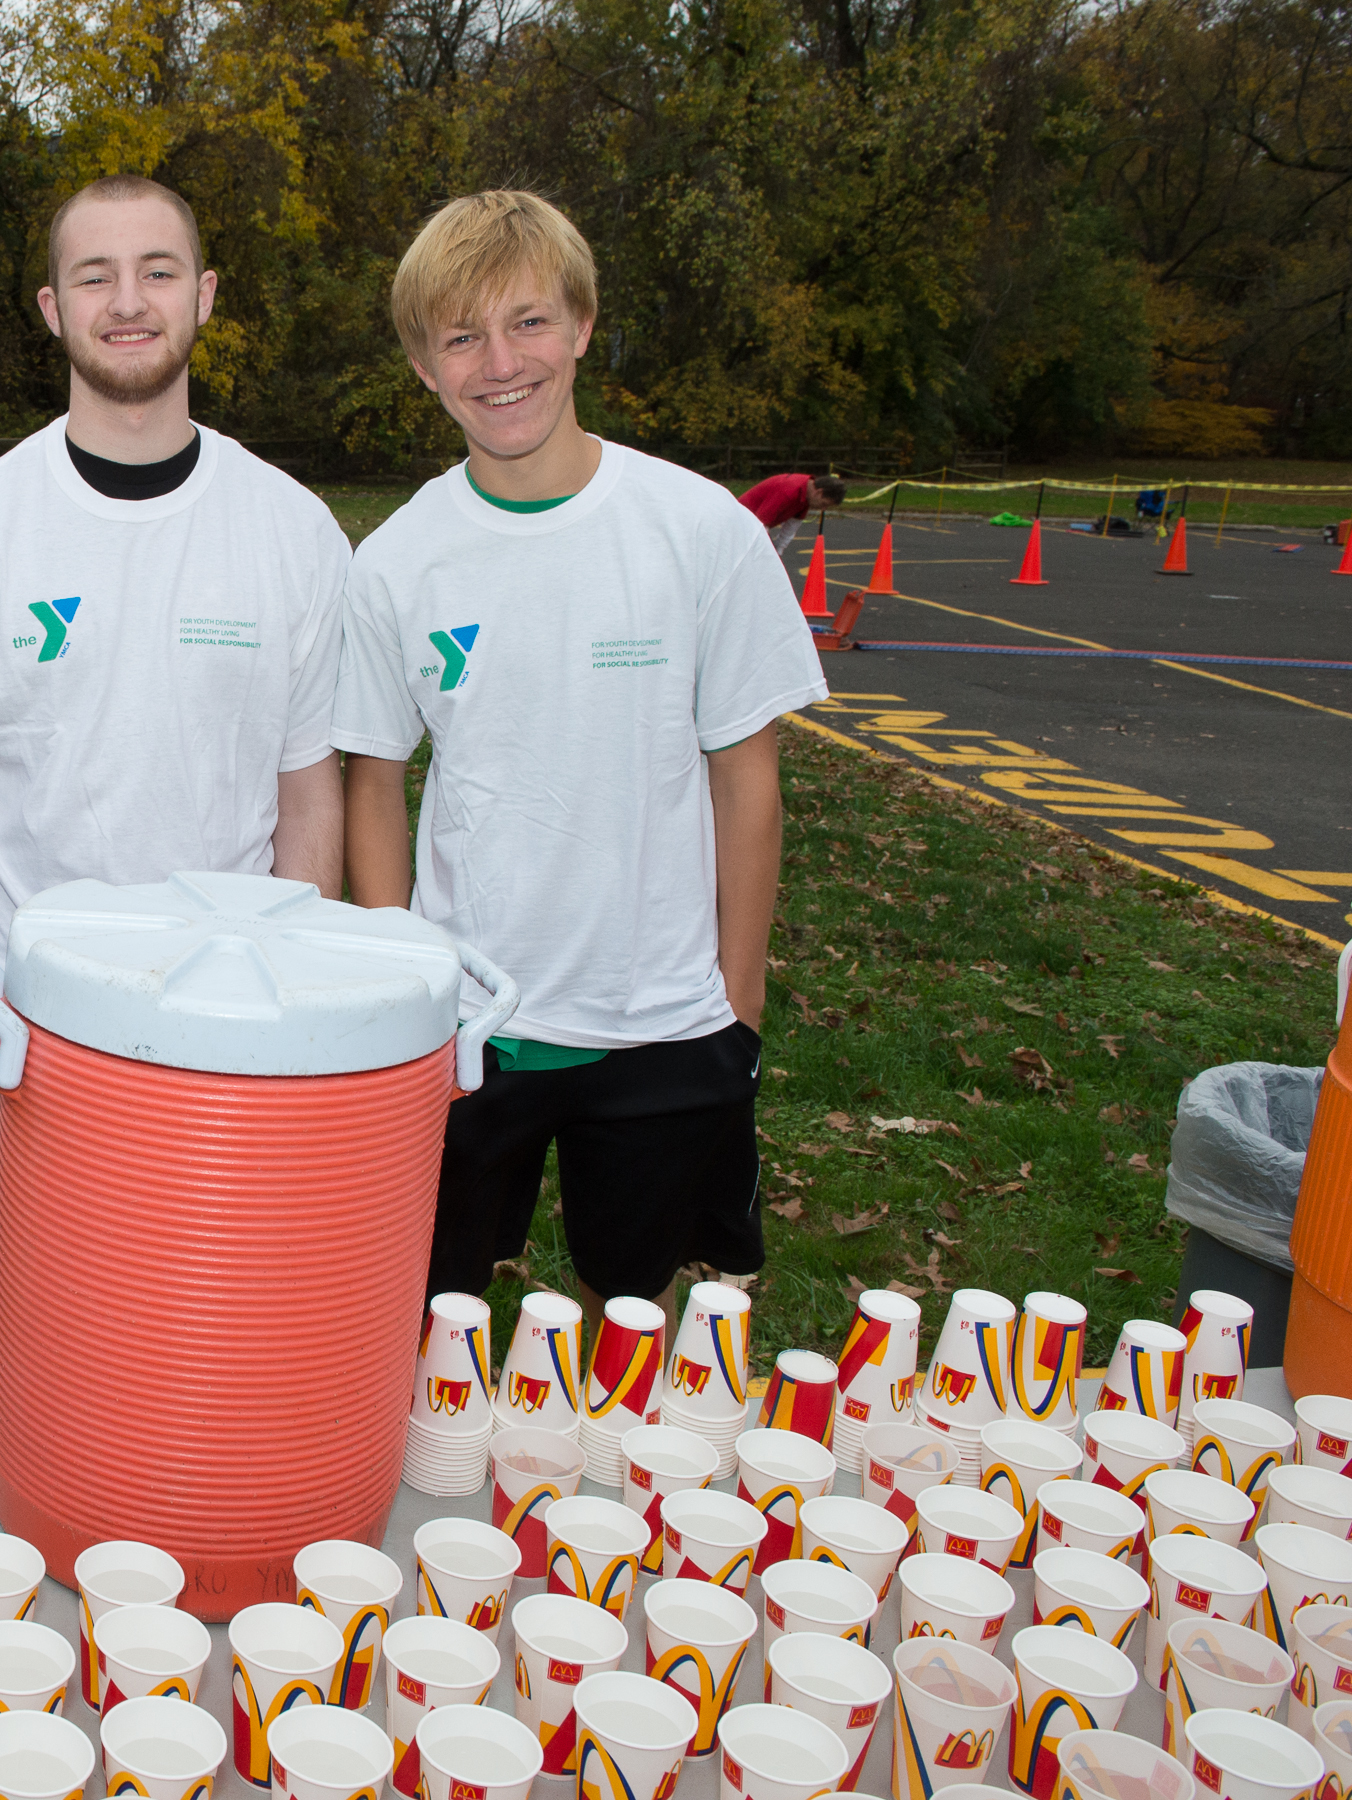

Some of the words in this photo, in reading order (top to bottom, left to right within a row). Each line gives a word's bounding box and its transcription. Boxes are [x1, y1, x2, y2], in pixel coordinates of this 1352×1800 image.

[180, 617, 193, 625] FOR
[193, 617, 215, 625] YOUTH
[215, 619, 257, 629] DEVELOPMENT
[193, 628, 220, 636] HEALTHY
[220, 629, 240, 637] LIVING
[12, 636, 37, 649] the
[194, 637, 217, 645] SOCIAL
[218, 639, 262, 649] RESPONSIBILITY
[605, 640, 628, 648] YOUTH
[59, 641, 71, 659] YMCA
[606, 650, 633, 658] HEALTHY
[593, 661, 606, 669] FOR
[607, 660, 631, 668] SOCIAL
[632, 657, 669, 668] RESOSIBILITY
[419, 664, 439, 678] the
[458, 671, 470, 688] YMCA
[811, 692, 1352, 927] TUDENT
